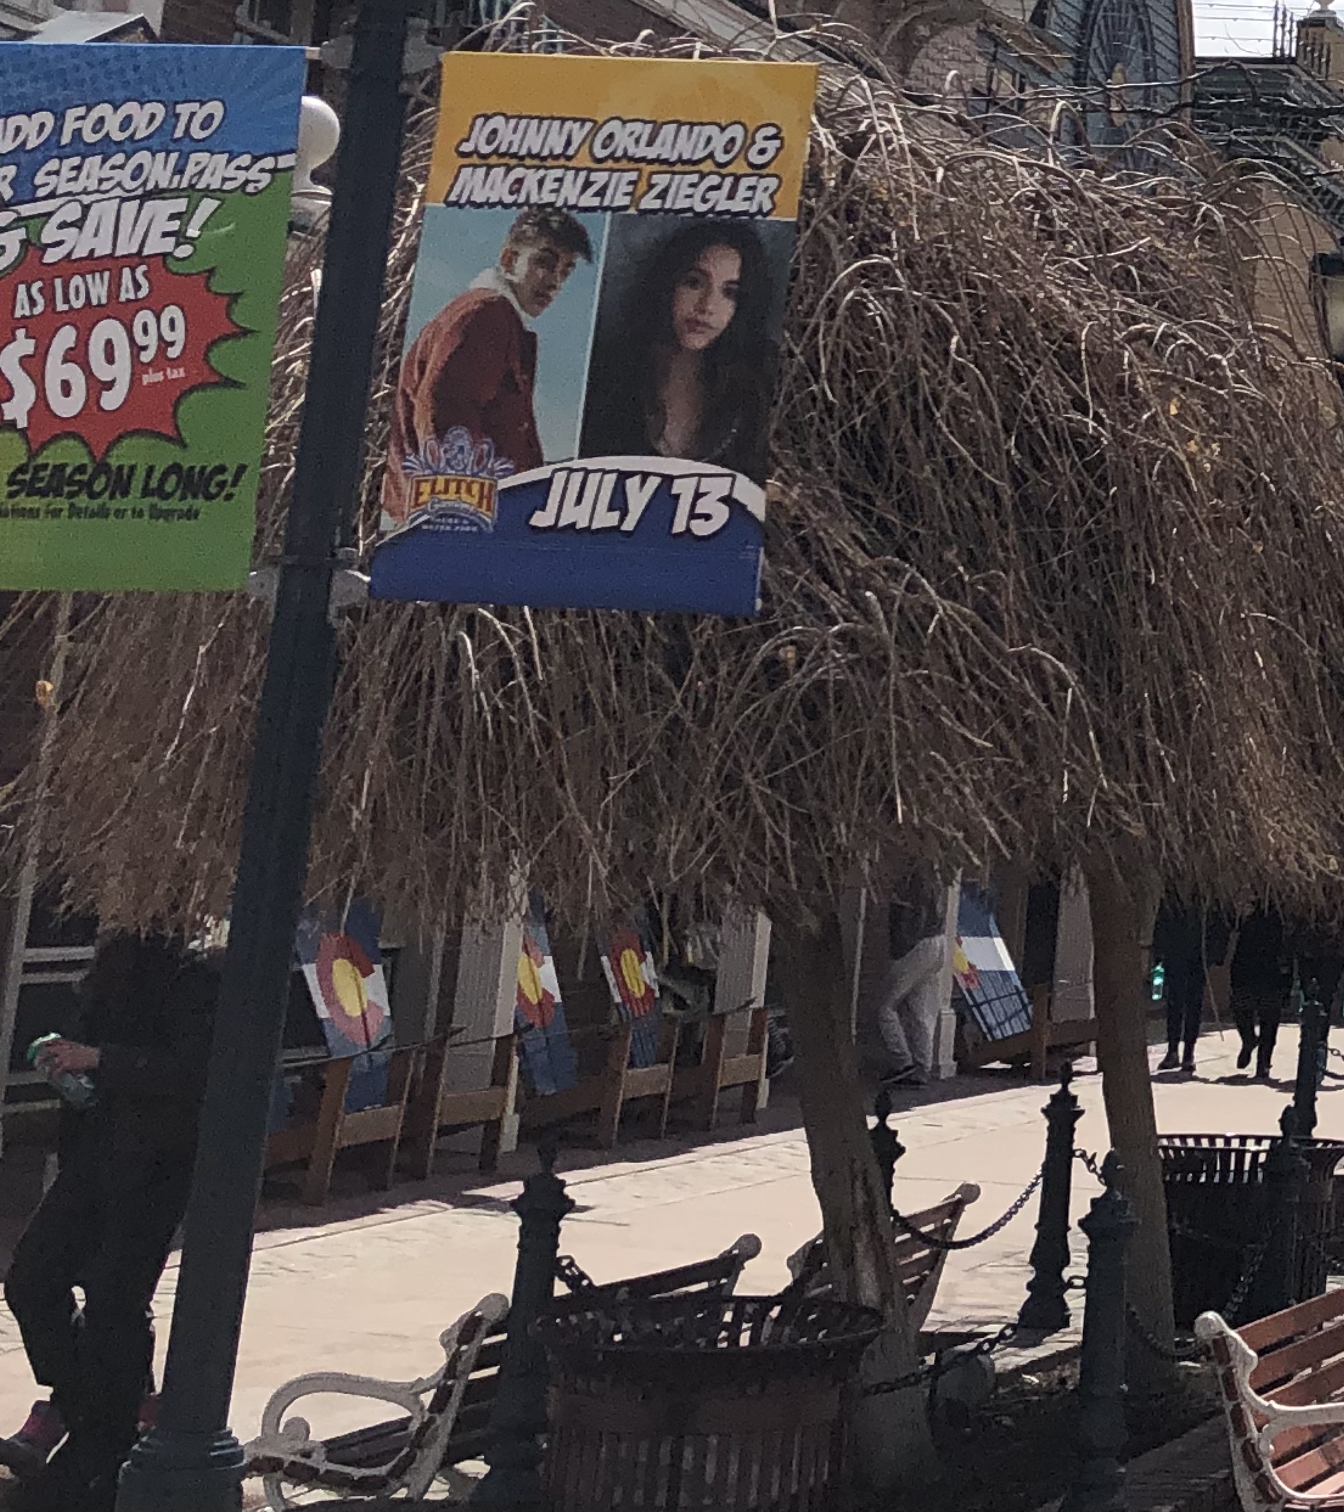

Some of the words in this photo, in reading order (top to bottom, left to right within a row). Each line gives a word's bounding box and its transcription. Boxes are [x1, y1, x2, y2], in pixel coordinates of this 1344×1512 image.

[61, 101, 165, 146] FOOD
[173, 100, 224, 139] TO
[458, 113, 594, 157] JOHNNY
[592, 118, 746, 165] ORLANDO
[748, 123, 783, 168] &
[34, 150, 180, 197] SEASON
[182, 152, 275, 194] PASS
[447, 165, 640, 209] MACKENZIE
[638, 172, 780, 216] ZIEGLER
[41, 197, 222, 264] SAVE!
[14, 281, 45, 318] AS
[55, 271, 110, 312] LOW
[119, 265, 149, 302] AS
[6, 461, 136, 501] SEASON
[141, 463, 248, 502] LONG!
[409, 476, 496, 512] ELITCH
[528, 468, 661, 532] JULY
[671, 473, 735, 538] 13
